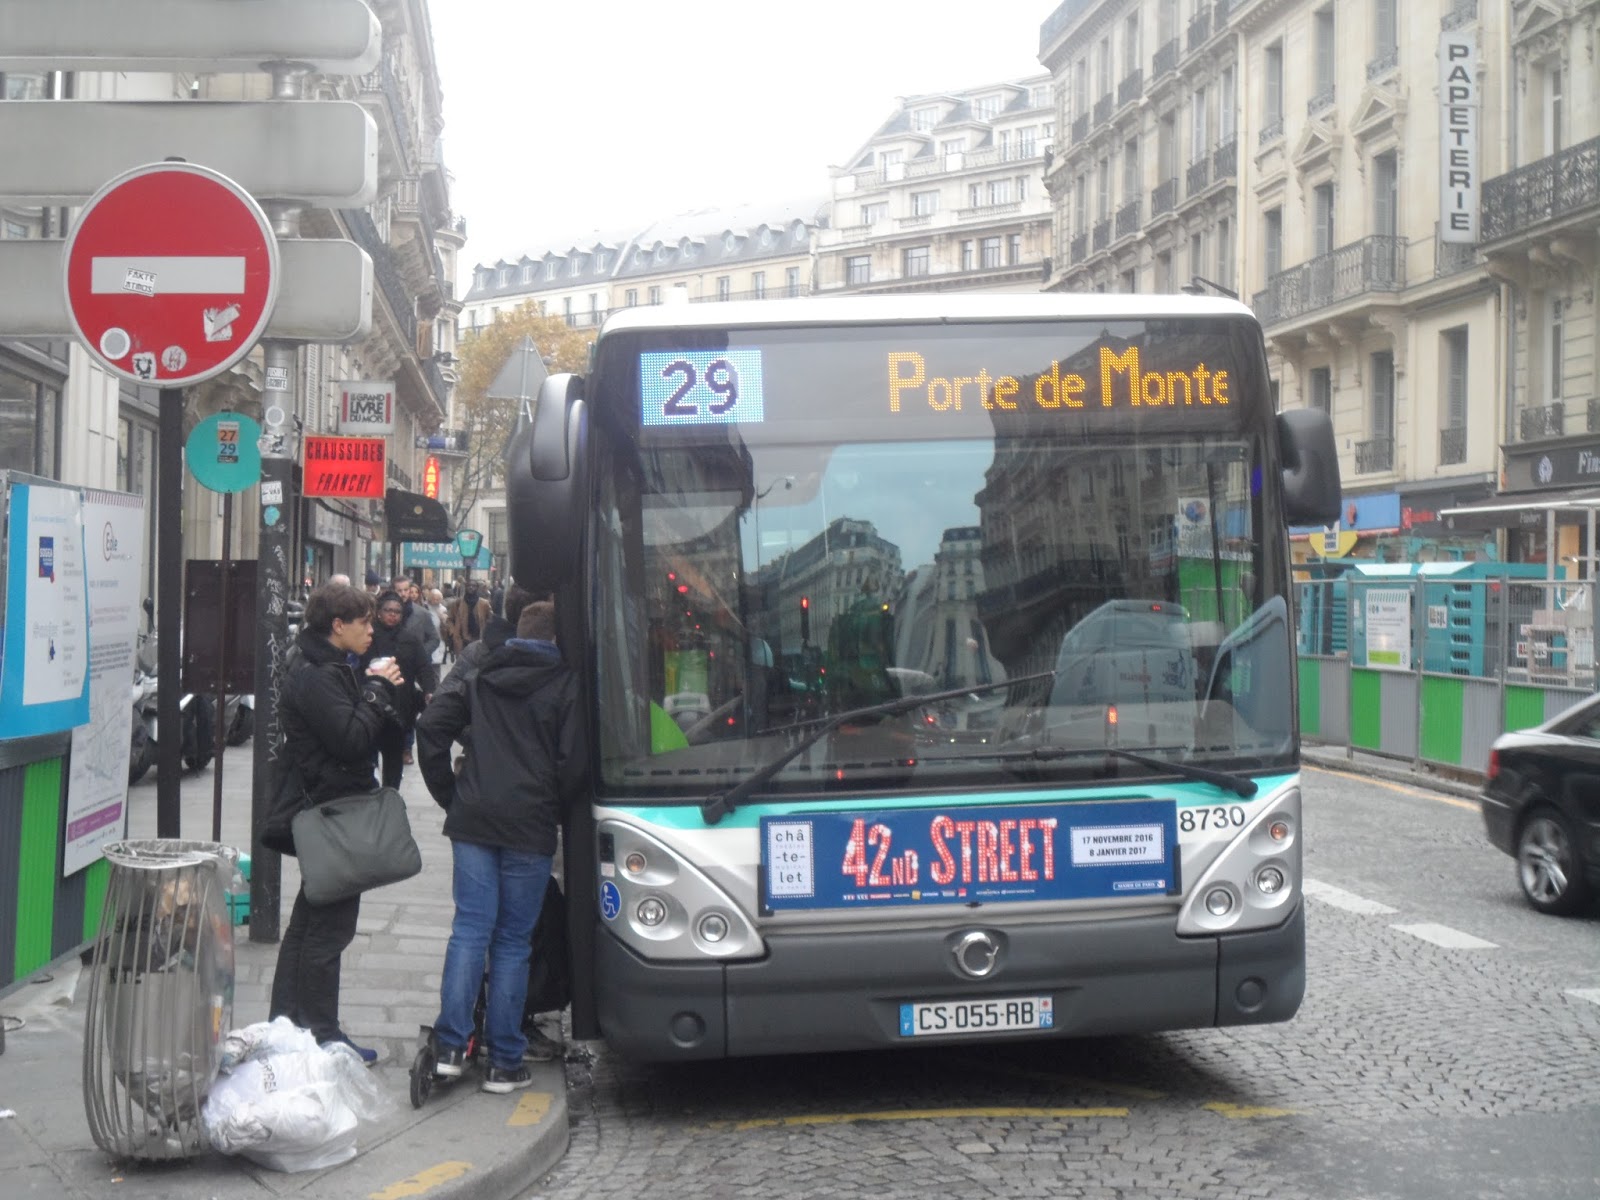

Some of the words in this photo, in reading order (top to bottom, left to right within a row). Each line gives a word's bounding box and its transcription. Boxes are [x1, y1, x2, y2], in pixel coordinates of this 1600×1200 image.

[1448, 44, 1471, 231] PAPETERIE
[888, 351, 1019, 412] Porte
[1035, 360, 1086, 408] de
[1100, 347, 1229, 407] Monte
[662, 360, 738, 416] 29
[357, 393, 385, 401] GRAND
[350, 401, 383, 415] LIVRE
[350, 414, 361, 422] DU
[362, 414, 384, 423] MOIS
[220, 430, 236, 441] 27
[220, 443, 236, 455] 29
[307, 441, 384, 462] CHAUSSURES
[317, 473, 372, 492] FRANCHI
[412, 542, 461, 553] MISTRA
[1179, 806, 1245, 832] 8730
[1082, 836, 1090, 845] 17
[1093, 835, 1133, 844] NOVEMBRE
[1135, 834, 1154, 842] 2016
[930, 815, 1058, 884] STREET
[1089, 849, 1095, 857] 8
[1096, 848, 1127, 857] JANVIER
[1129, 847, 1147, 855] 2017
[780, 871, 803, 883] let
[1040, 1012, 1053, 1025] 75
[904, 1023, 910, 1031] F
